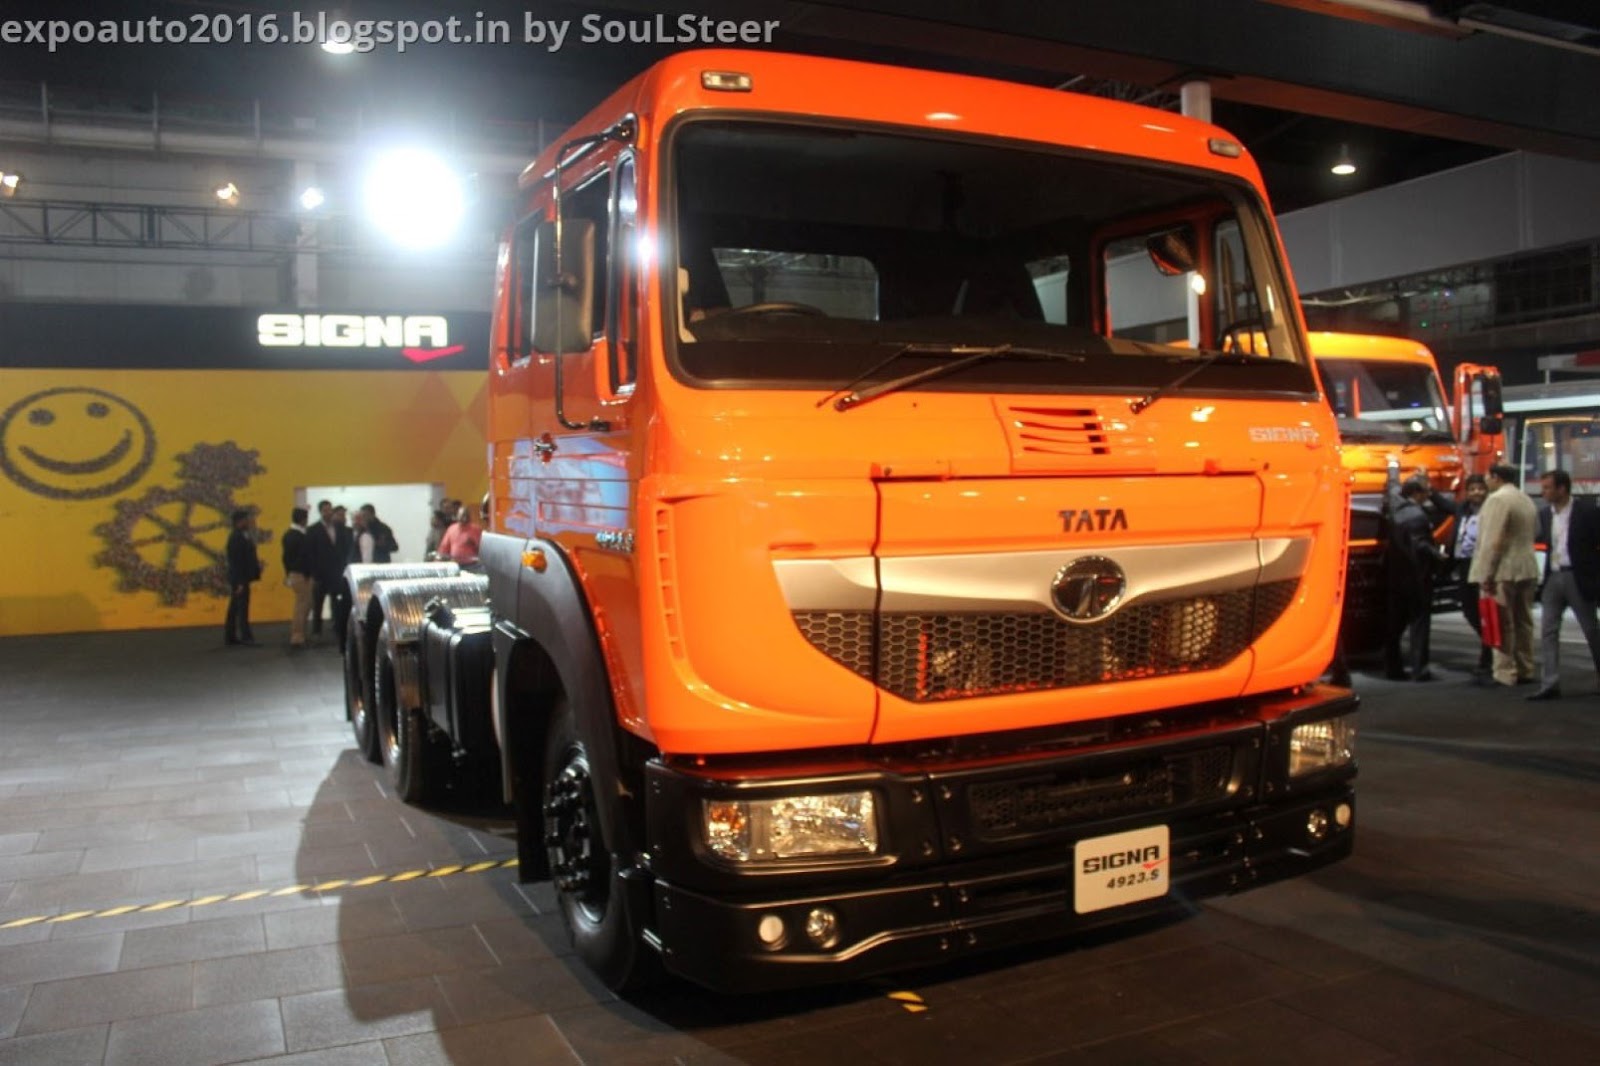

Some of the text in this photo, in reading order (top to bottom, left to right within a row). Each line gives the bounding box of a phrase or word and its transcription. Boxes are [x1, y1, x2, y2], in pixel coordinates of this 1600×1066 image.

[257, 314, 448, 347] SIGNA
[1058, 508, 1128, 533] TATA
[1083, 845, 1160, 874] SIGNA
